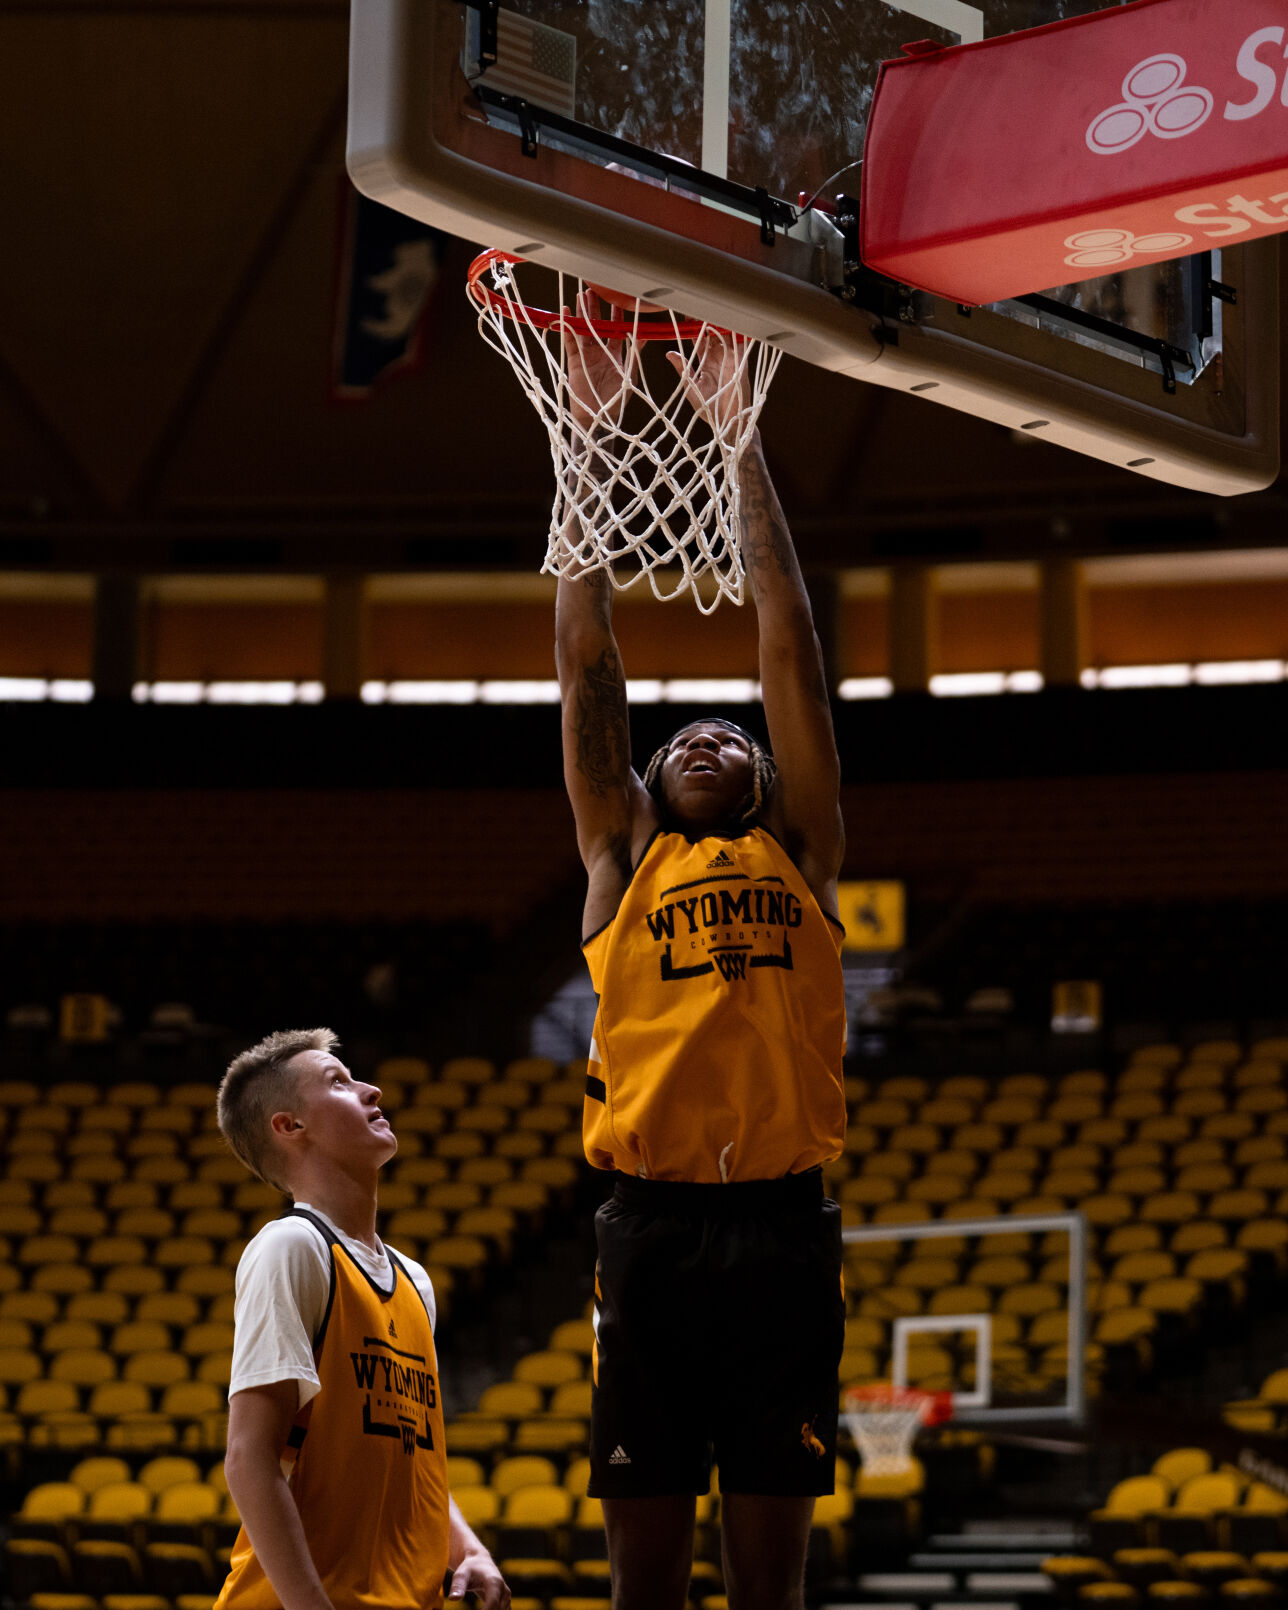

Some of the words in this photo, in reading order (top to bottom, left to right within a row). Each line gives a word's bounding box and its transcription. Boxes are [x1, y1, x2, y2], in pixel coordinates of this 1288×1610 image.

[706, 861, 735, 869] adidas
[646, 889, 802, 941] WYOMING
[690, 931, 771, 949] COWBOYS
[350, 1352, 436, 1409] WYOMING
